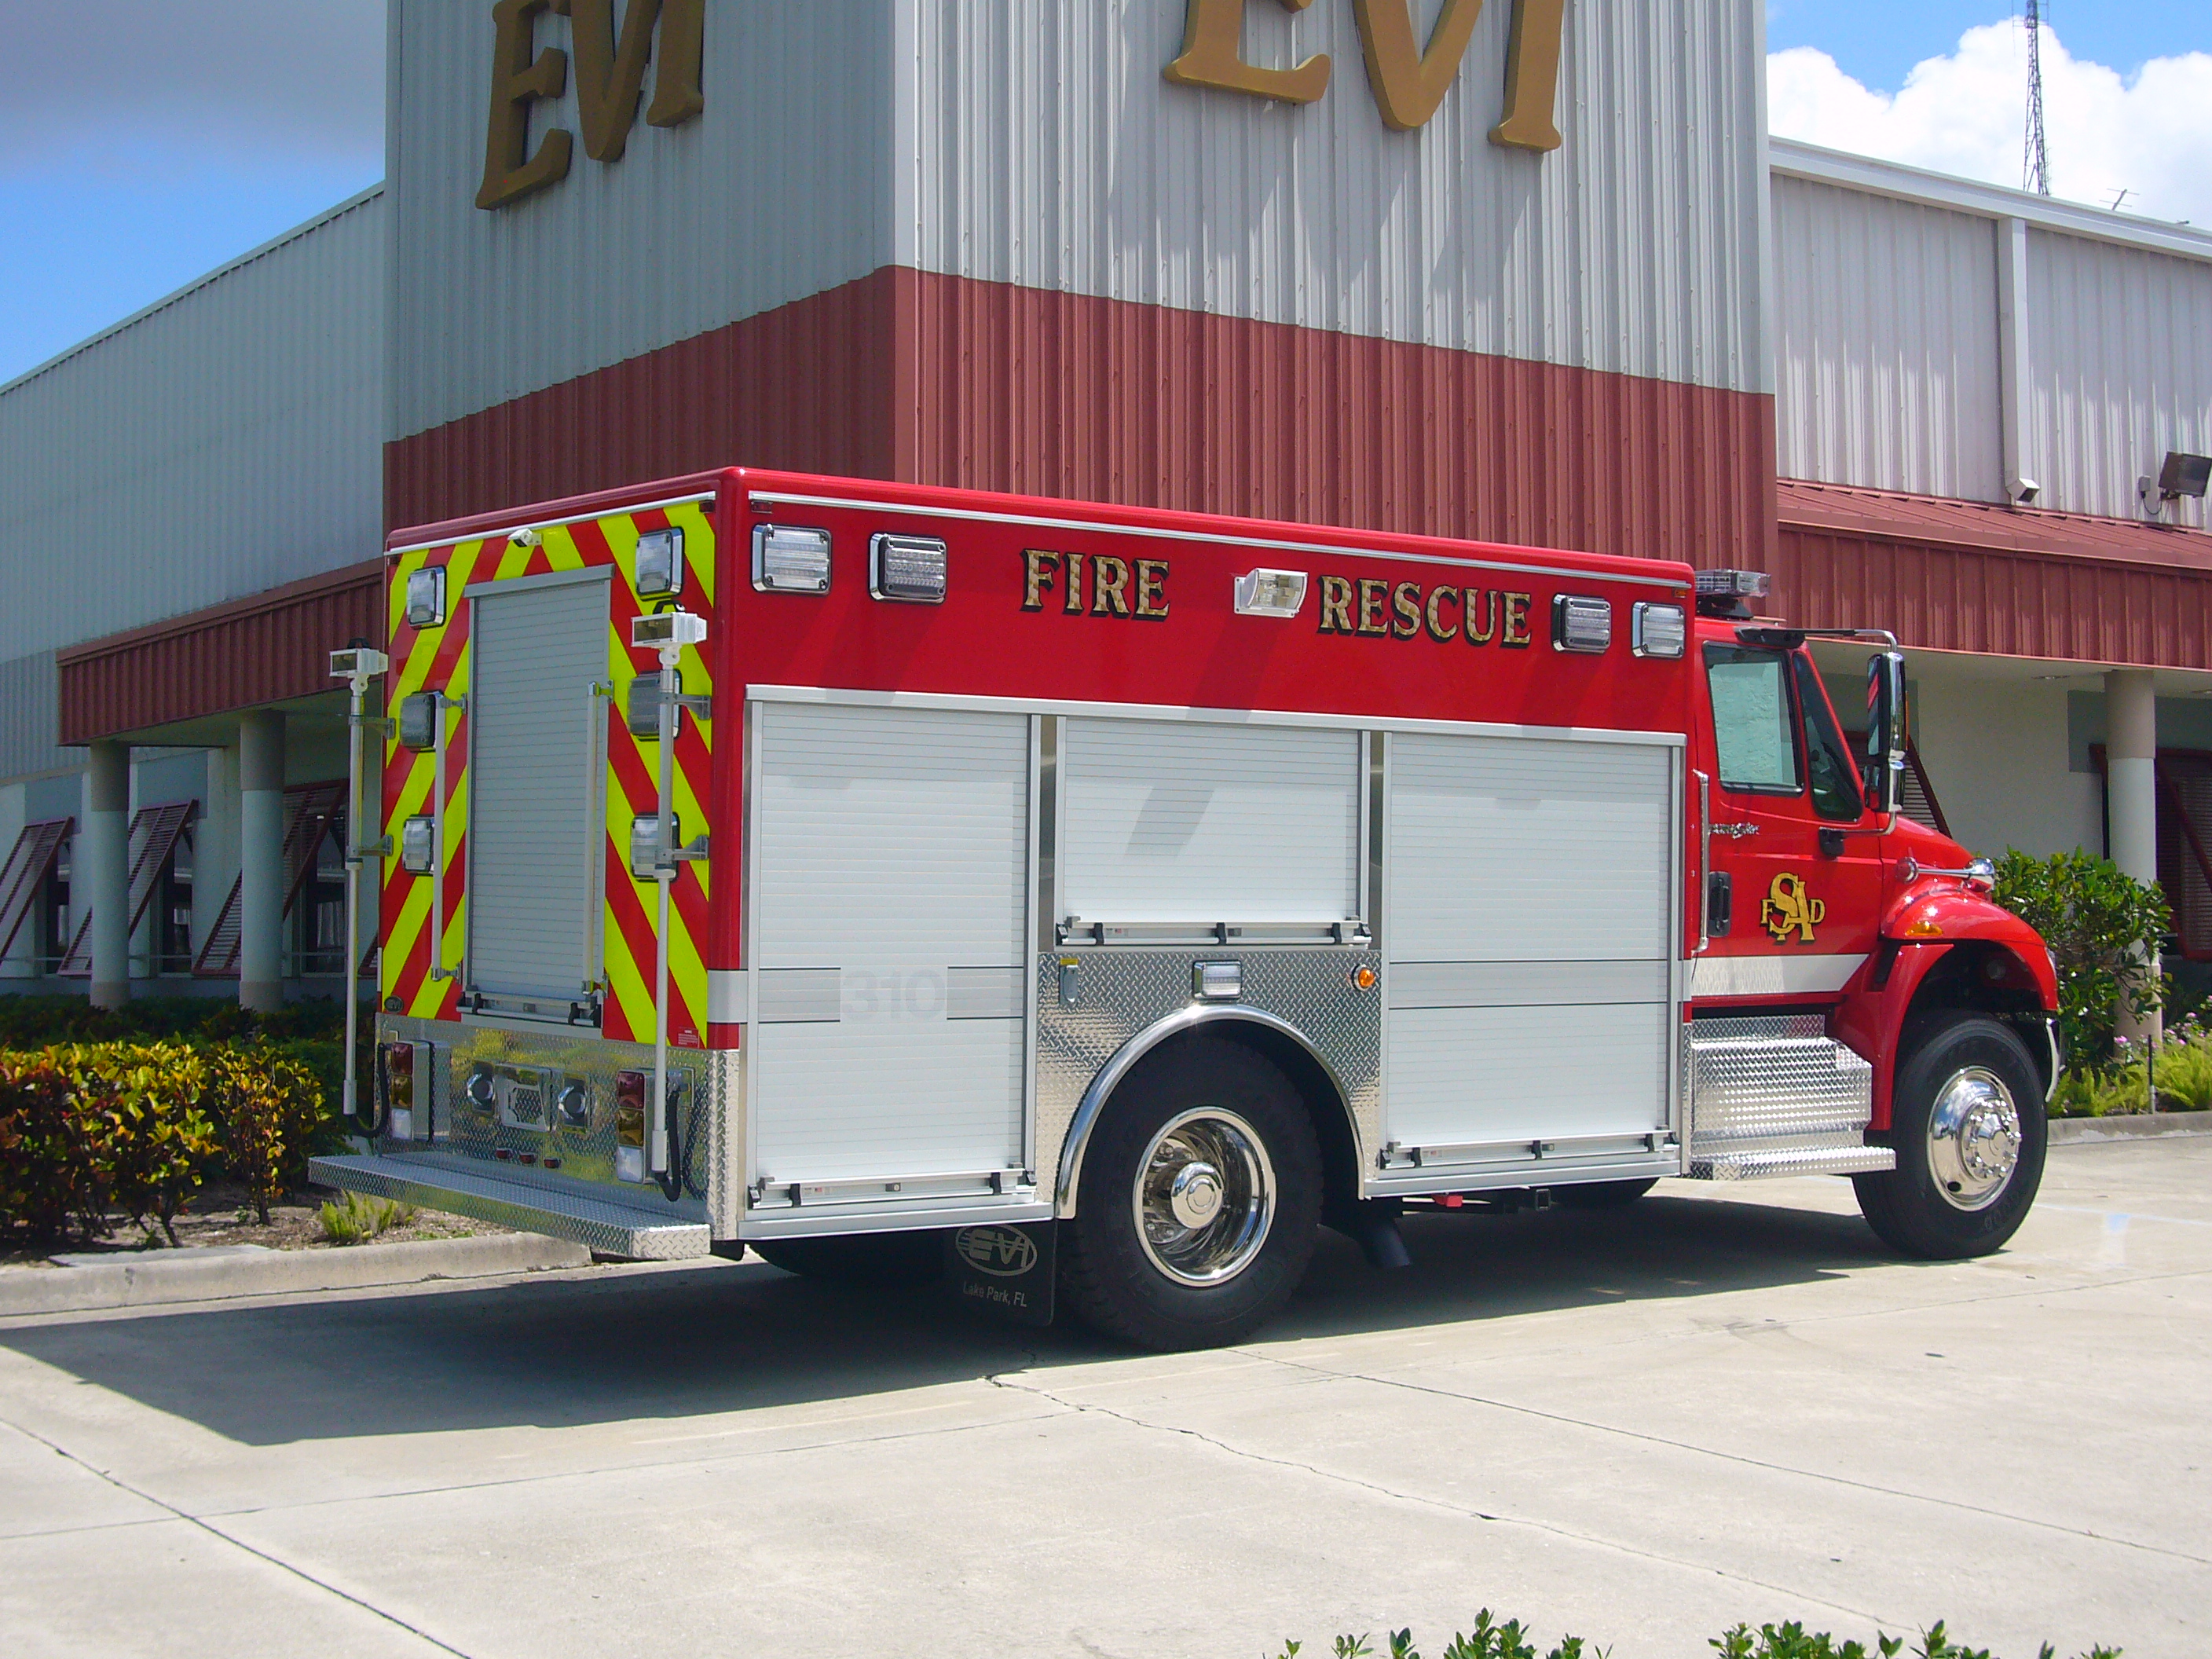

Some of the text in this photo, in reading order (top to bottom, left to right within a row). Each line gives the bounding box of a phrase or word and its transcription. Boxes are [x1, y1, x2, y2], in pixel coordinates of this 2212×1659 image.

[1020, 548, 1532, 650] FIRE RESCUE
[841, 969, 946, 1020] 310
[963, 1281, 1027, 1308] Lake Park, FL
